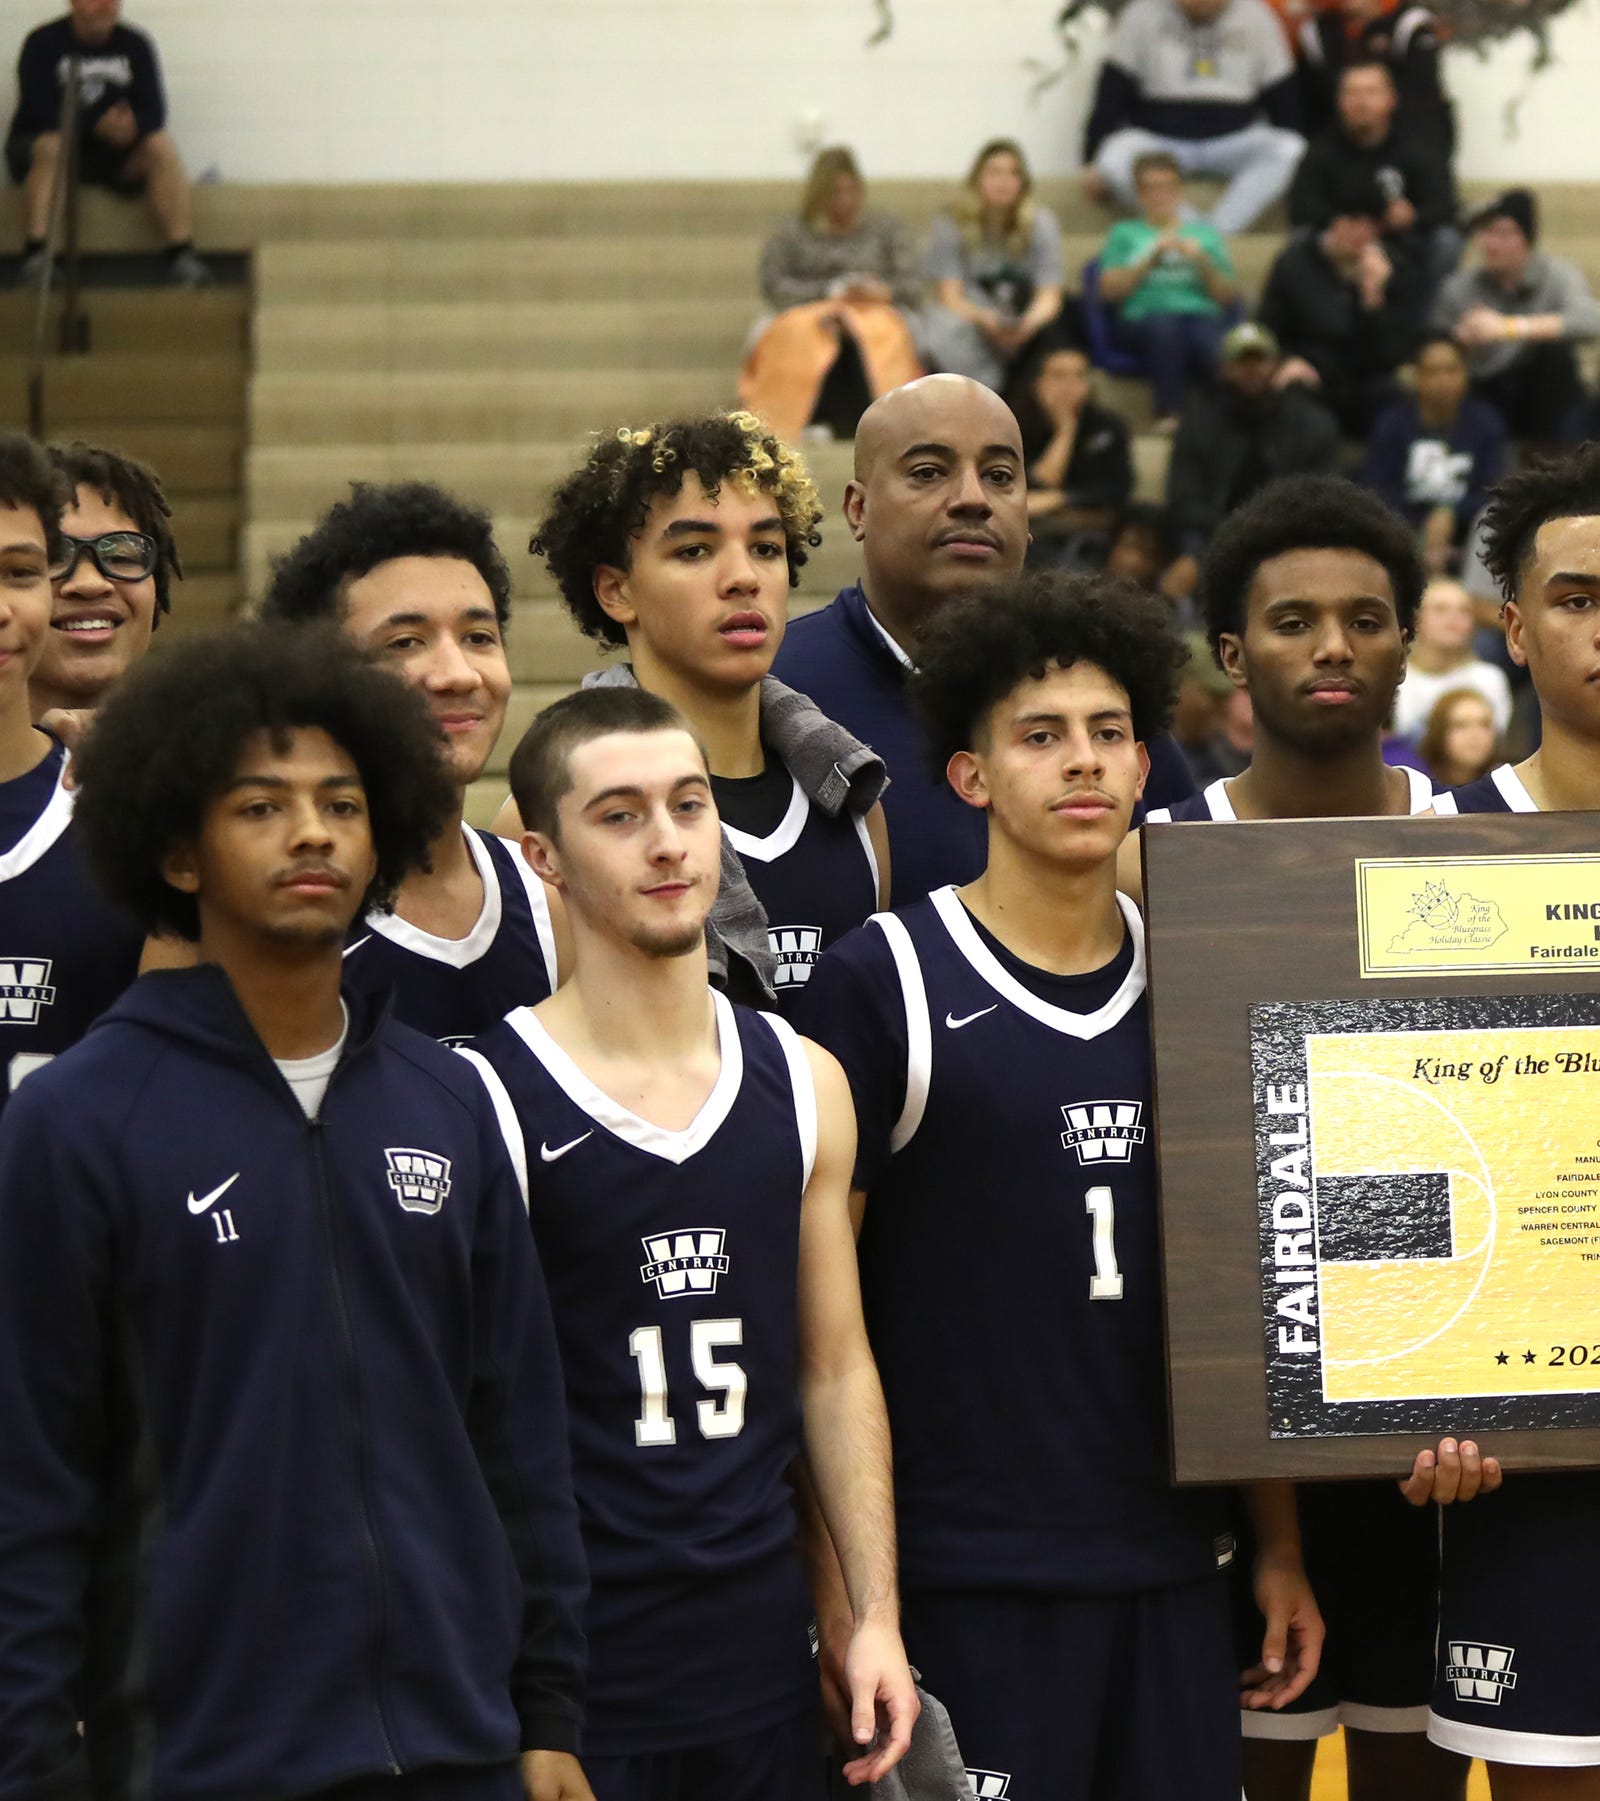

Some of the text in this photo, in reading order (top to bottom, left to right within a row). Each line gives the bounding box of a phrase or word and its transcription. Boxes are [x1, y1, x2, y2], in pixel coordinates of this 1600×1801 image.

[777, 952, 819, 964] NTRA
[1530, 944, 1599, 958] Fairdale
[0, 985, 49, 1001] TRAL
[1412, 1058, 1473, 1085] King
[1479, 1055, 1508, 1084] of
[1515, 1055, 1550, 1076] the
[1066, 1127, 1140, 1145] CENTRAL
[393, 1173, 446, 1191] CENTRAL
[1535, 1189, 1599, 1199] LYON COUNTY
[1265, 1083, 1318, 1354] FAIRDALE
[1517, 1205, 1597, 1215] SPENCER COUNTY
[211, 1208, 240, 1243] 11
[1520, 1221, 1600, 1231] WARREN CENTRAL
[1084, 1186, 1124, 1300] 1
[1540, 1236, 1589, 1245] SAGEMONT
[646, 1257, 725, 1278] CENTRAL
[628, 1317, 748, 1447] 15
[1448, 1667, 1511, 1685] CENTRAL
